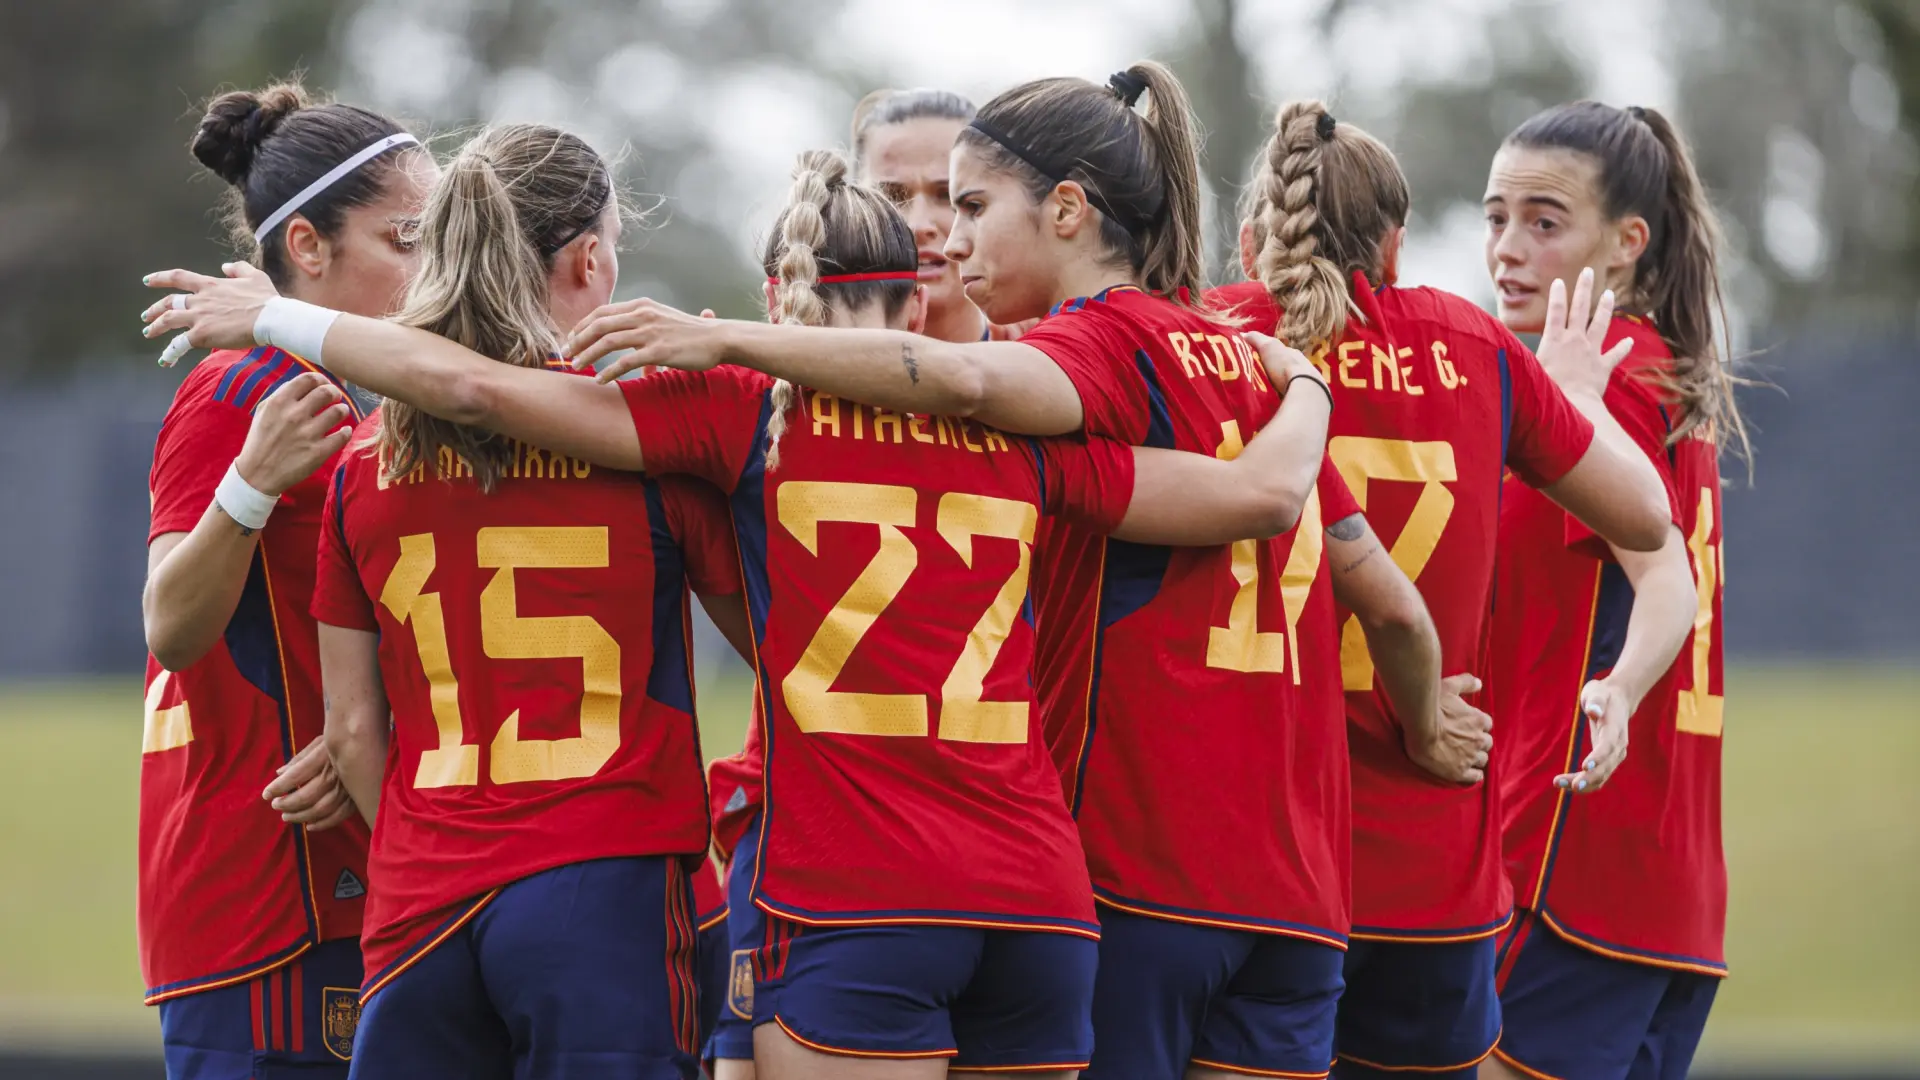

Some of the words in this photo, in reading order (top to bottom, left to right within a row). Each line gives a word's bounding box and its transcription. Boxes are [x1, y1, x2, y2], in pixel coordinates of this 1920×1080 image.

[1279, 335, 1424, 395] RENE
[1431, 340, 1467, 390] G.
[380, 526, 622, 789] 15
[776, 481, 1038, 744] 22
